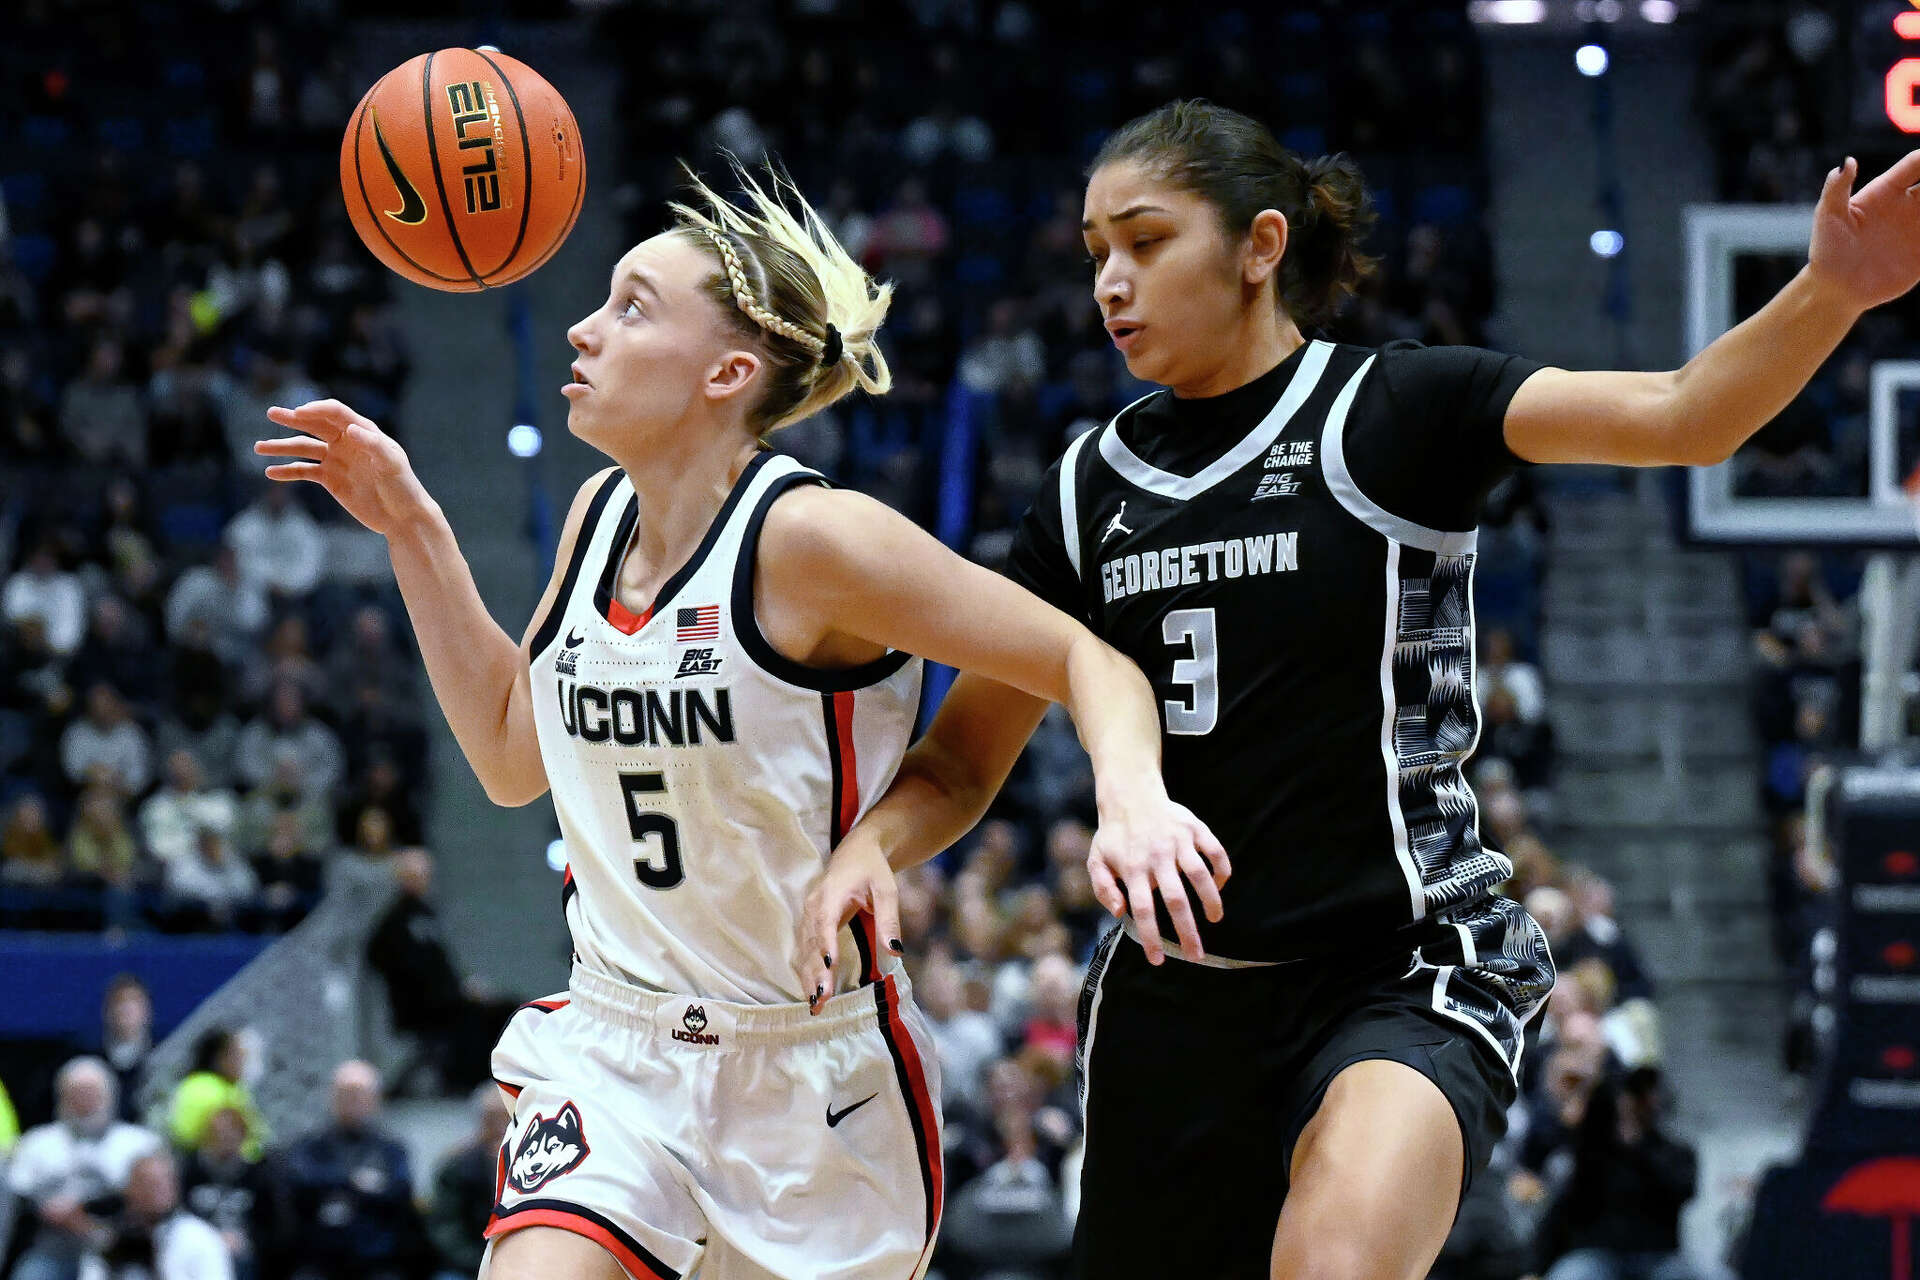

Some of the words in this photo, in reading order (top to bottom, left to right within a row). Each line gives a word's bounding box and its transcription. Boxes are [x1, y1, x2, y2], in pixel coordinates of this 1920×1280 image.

[445, 81, 501, 214] ELITE
[1270, 444, 1287, 456] BE
[1290, 441, 1314, 454] THE
[1263, 453, 1314, 469] CHANGE
[1259, 472, 1294, 485] BIG
[1254, 481, 1302, 496] EAST
[1101, 531, 1299, 604] GEORGETOWN
[682, 648, 714, 661] BIG
[678, 658, 723, 672] EAST
[1162, 607, 1219, 736] 3
[558, 677, 737, 748] UCONN
[617, 770, 686, 891] 5
[671, 1029, 720, 1045] UCONN
